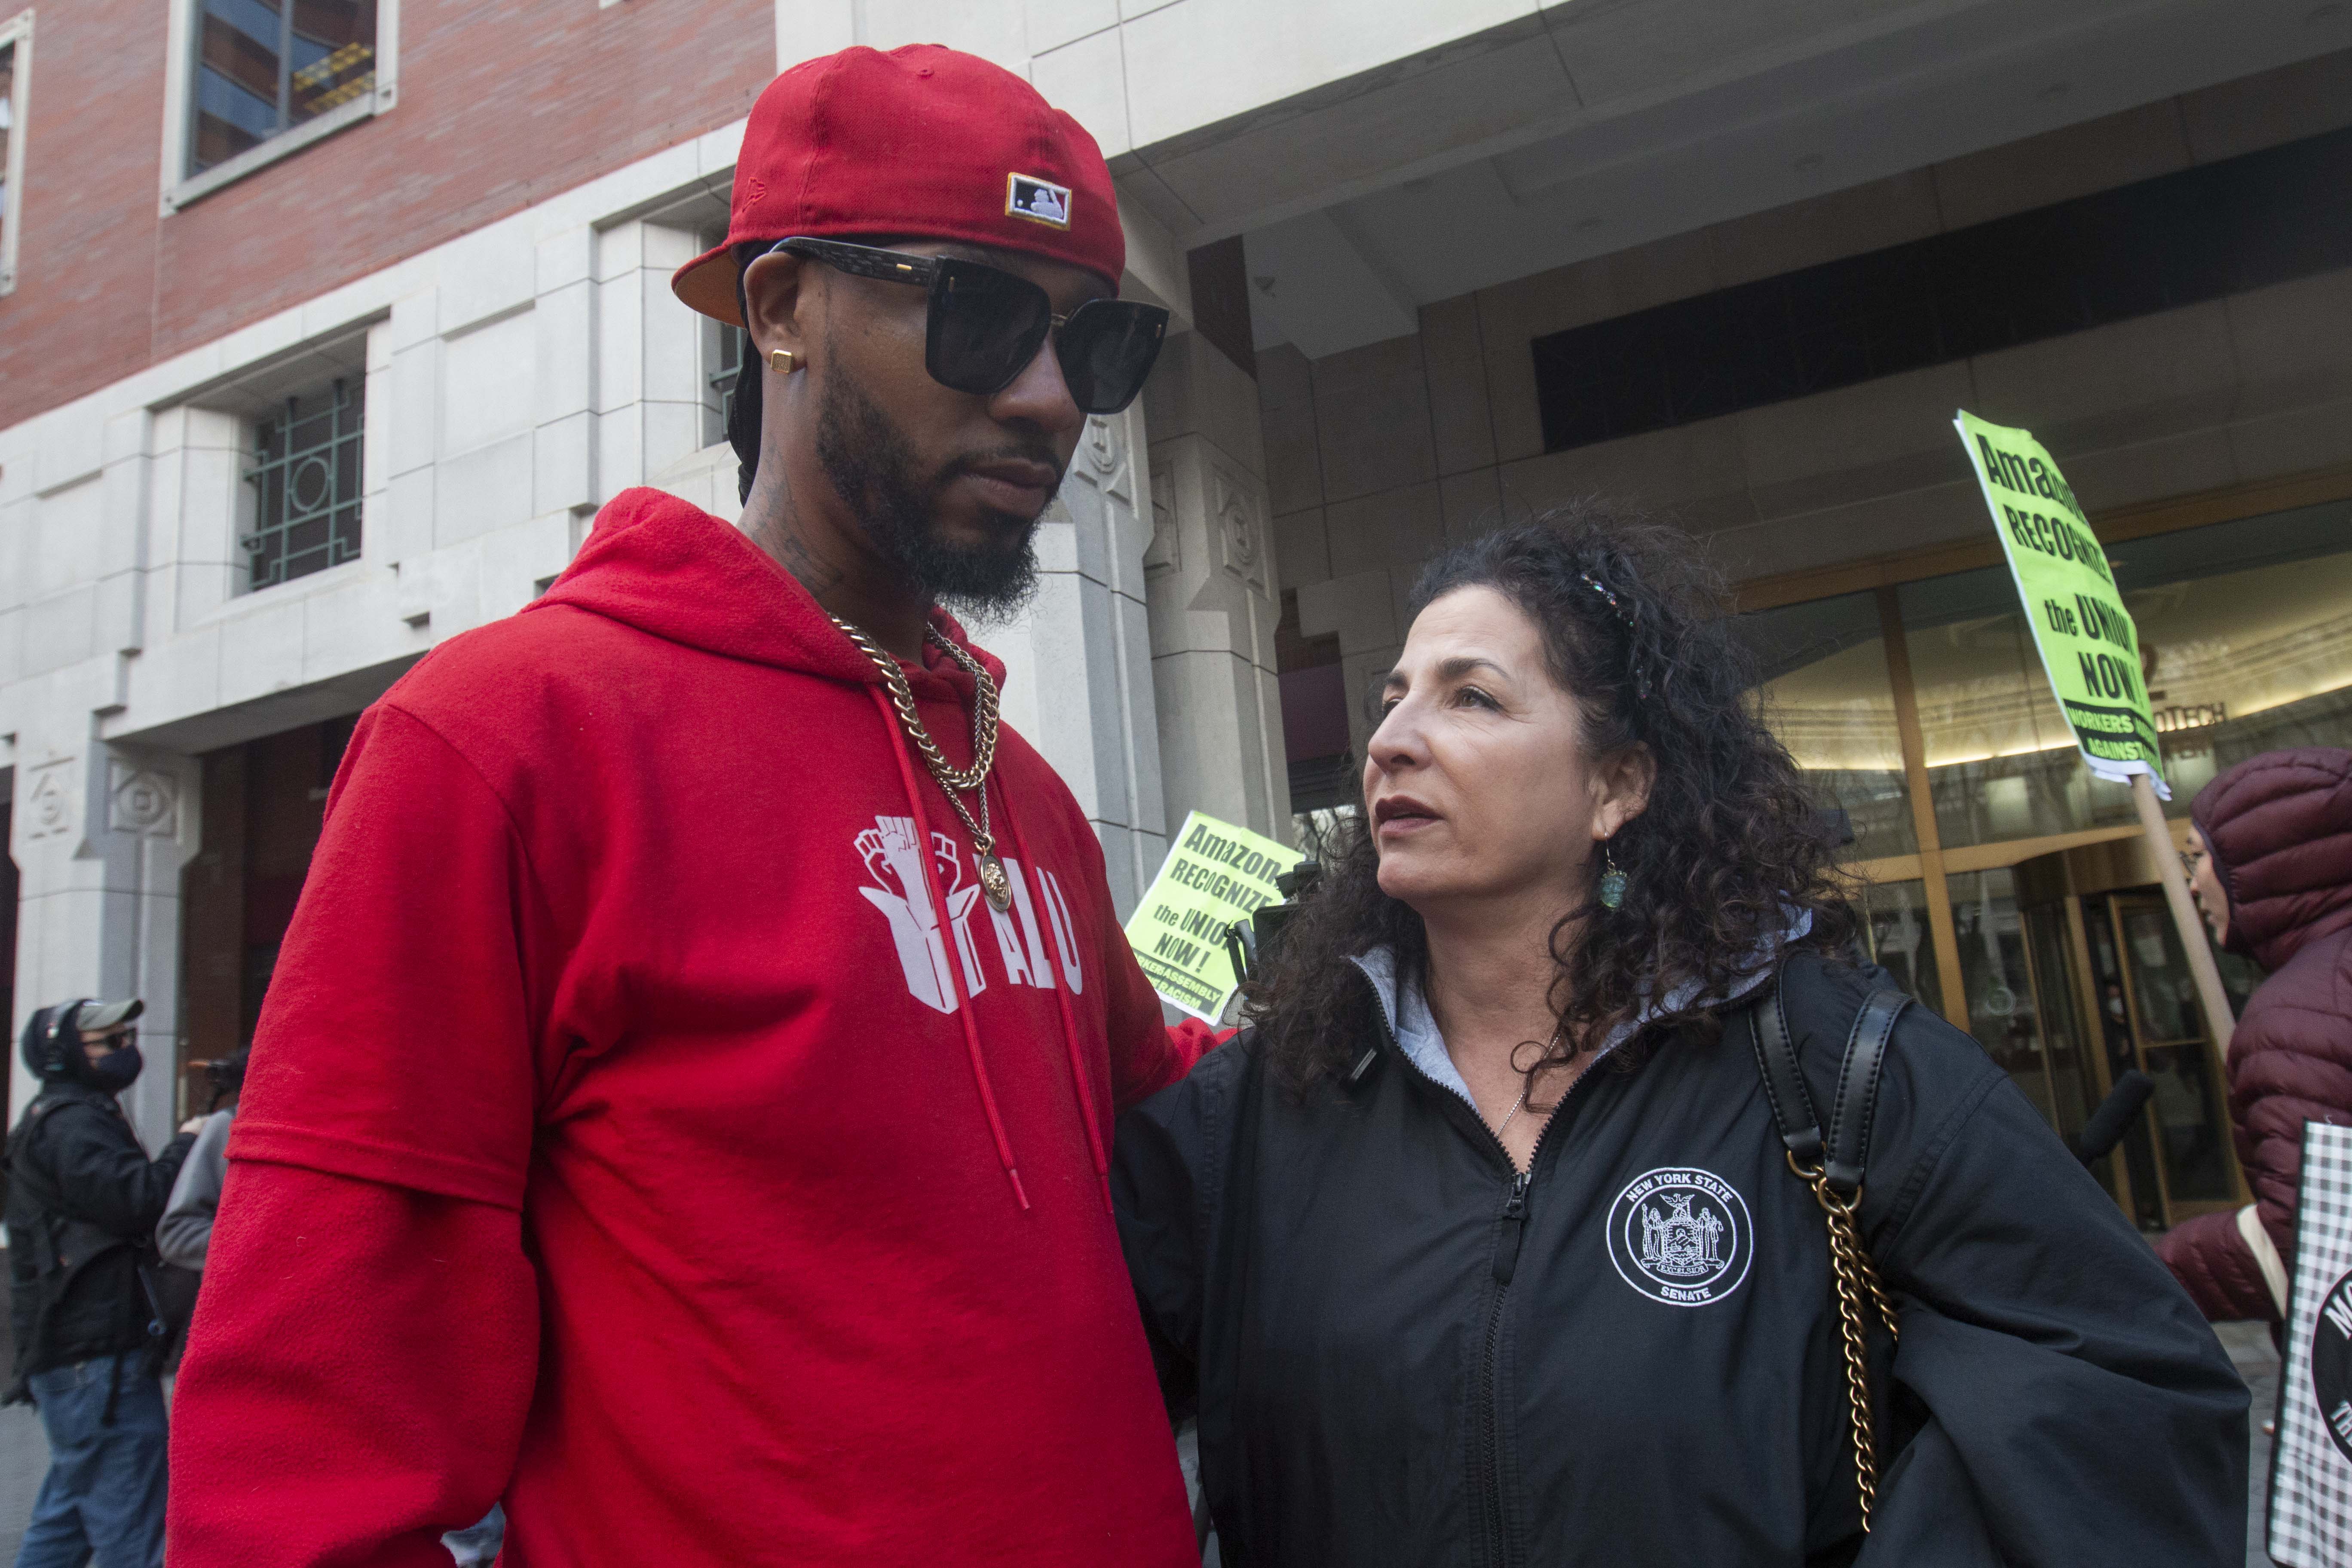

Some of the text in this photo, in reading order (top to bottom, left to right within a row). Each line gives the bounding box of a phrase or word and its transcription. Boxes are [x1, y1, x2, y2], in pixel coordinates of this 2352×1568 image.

[2044, 598, 2078, 636] the
[2067, 707, 2135, 733] WORKERS
[2087, 737, 2146, 760] AGAINST
[1153, 903, 1179, 926] the
[1160, 981, 1202, 1009] RACISM
[1163, 968, 1220, 1003] ASSEMBLY
[1626, 1173, 1733, 1203] NEW YORK STATE
[1660, 1264, 1706, 1274] EXCELSIOR
[1660, 1286, 1712, 1301] SENATE
